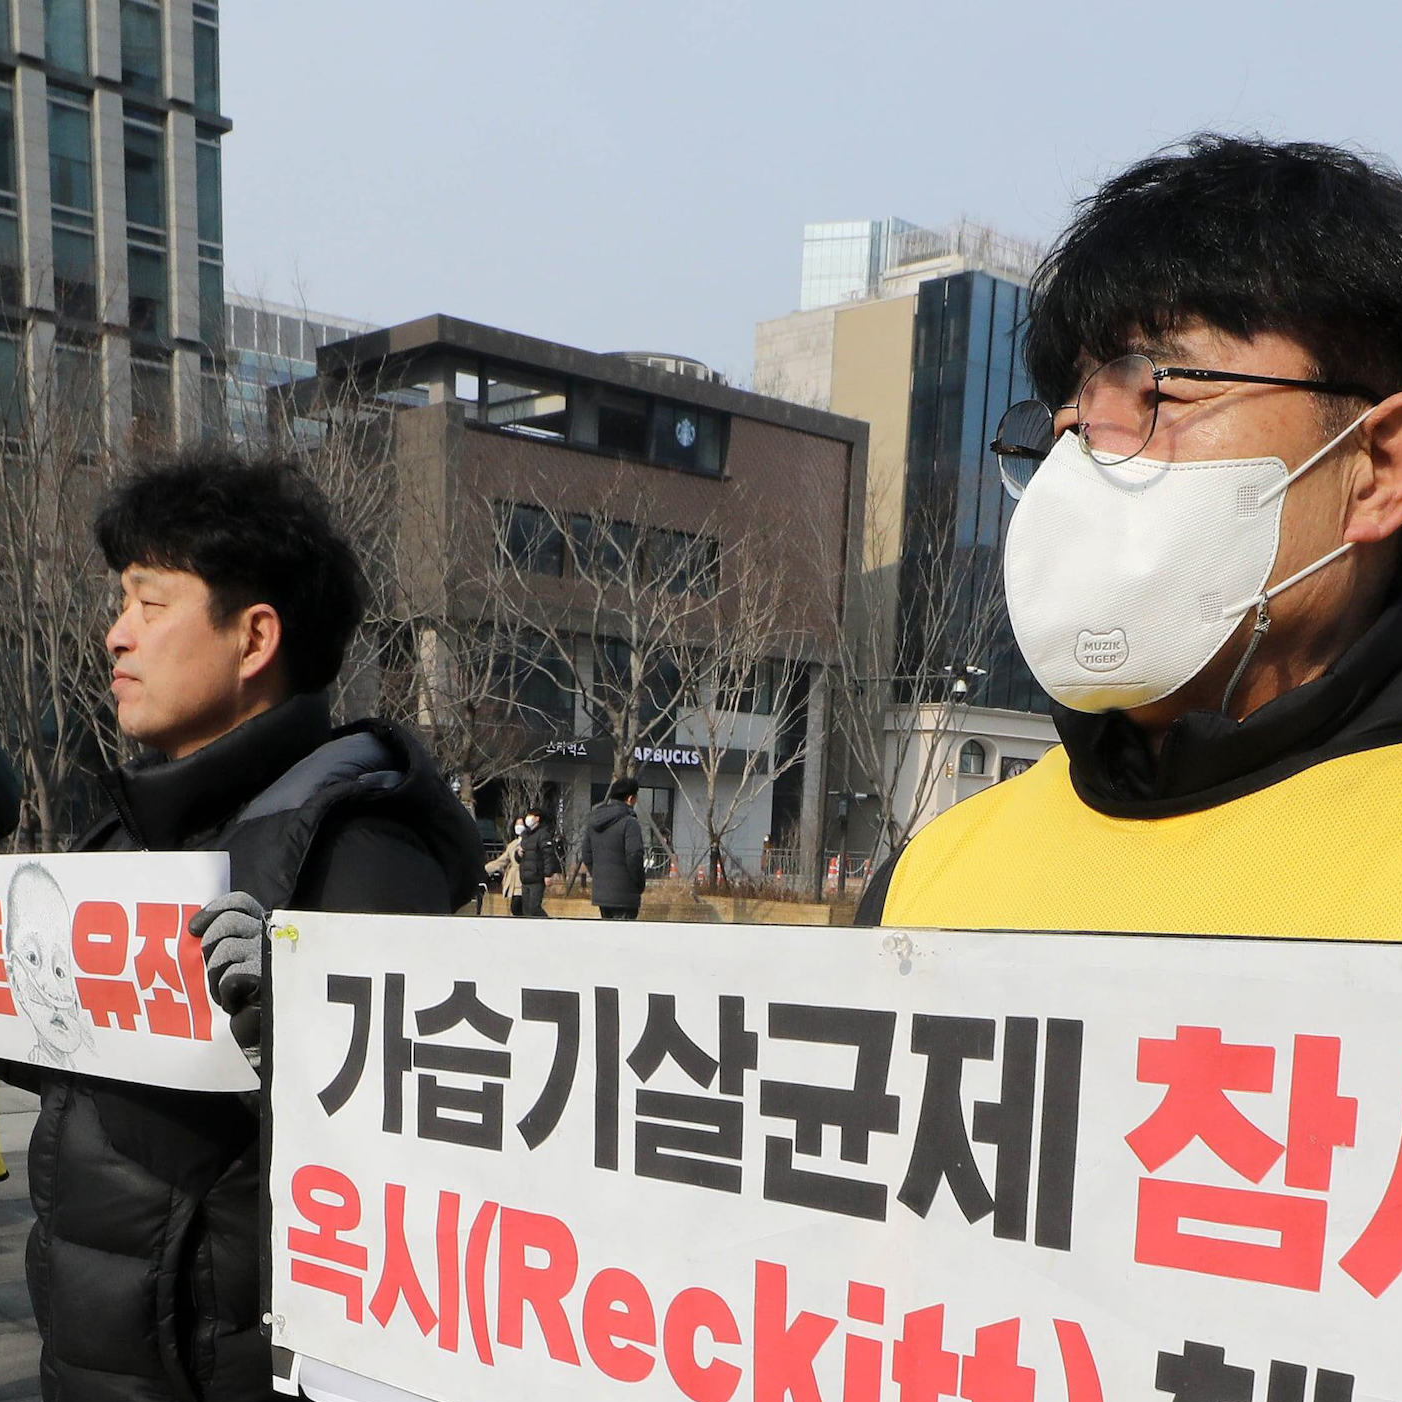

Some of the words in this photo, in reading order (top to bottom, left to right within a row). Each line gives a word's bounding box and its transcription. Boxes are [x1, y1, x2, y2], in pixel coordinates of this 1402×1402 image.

[1084, 641, 1121, 651] MUZIK
[1084, 655, 1118, 664] TIGER
[633, 746, 701, 765] ARBUCKS
[71, 900, 212, 1042] 유죄
[316, 971, 1086, 1253] 가습기살균제
